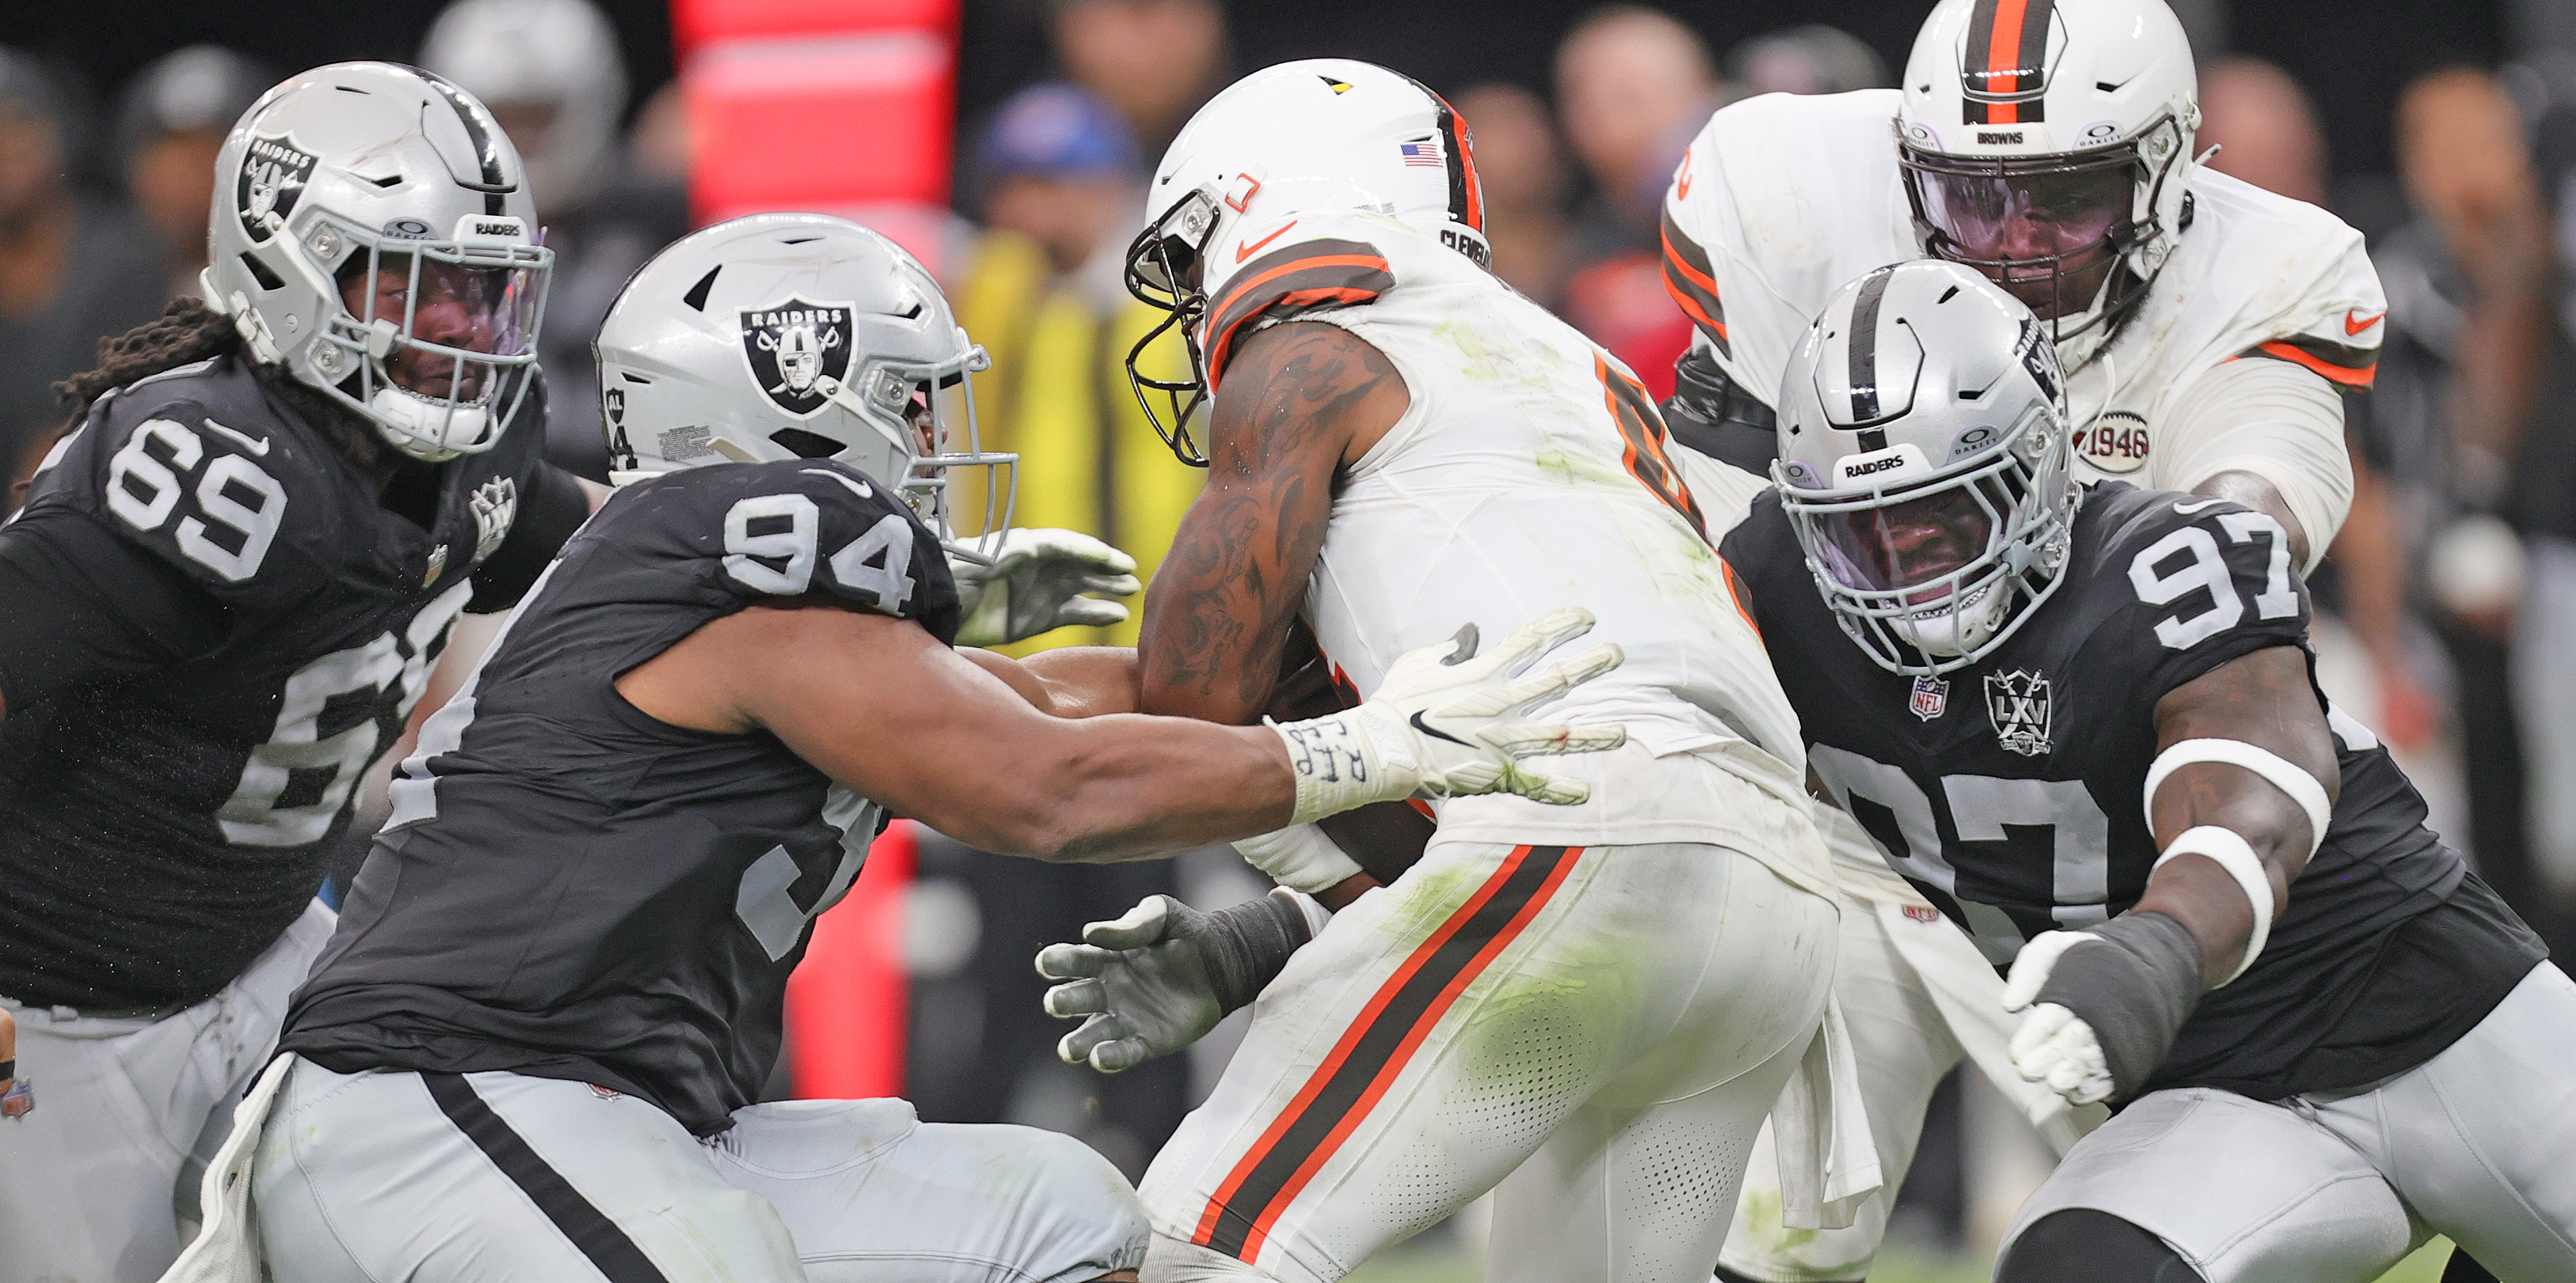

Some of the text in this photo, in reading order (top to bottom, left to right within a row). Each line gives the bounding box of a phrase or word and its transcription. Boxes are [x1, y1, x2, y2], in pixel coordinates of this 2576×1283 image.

[1978, 132, 2023, 145] BROWNS
[251, 139, 311, 169] RAIDERS
[475, 223, 520, 236] RAIDERS
[751, 309, 843, 327] RAIDERS
[609, 394, 623, 410] AL
[2087, 426, 2149, 459] 1946
[1845, 454, 1904, 478] RAIDERS
[106, 418, 288, 583] 69
[722, 493, 916, 619] 94
[2127, 511, 2300, 651] 97
[1915, 693, 1940, 712] NFL
[1995, 695, 2047, 725] LXV
